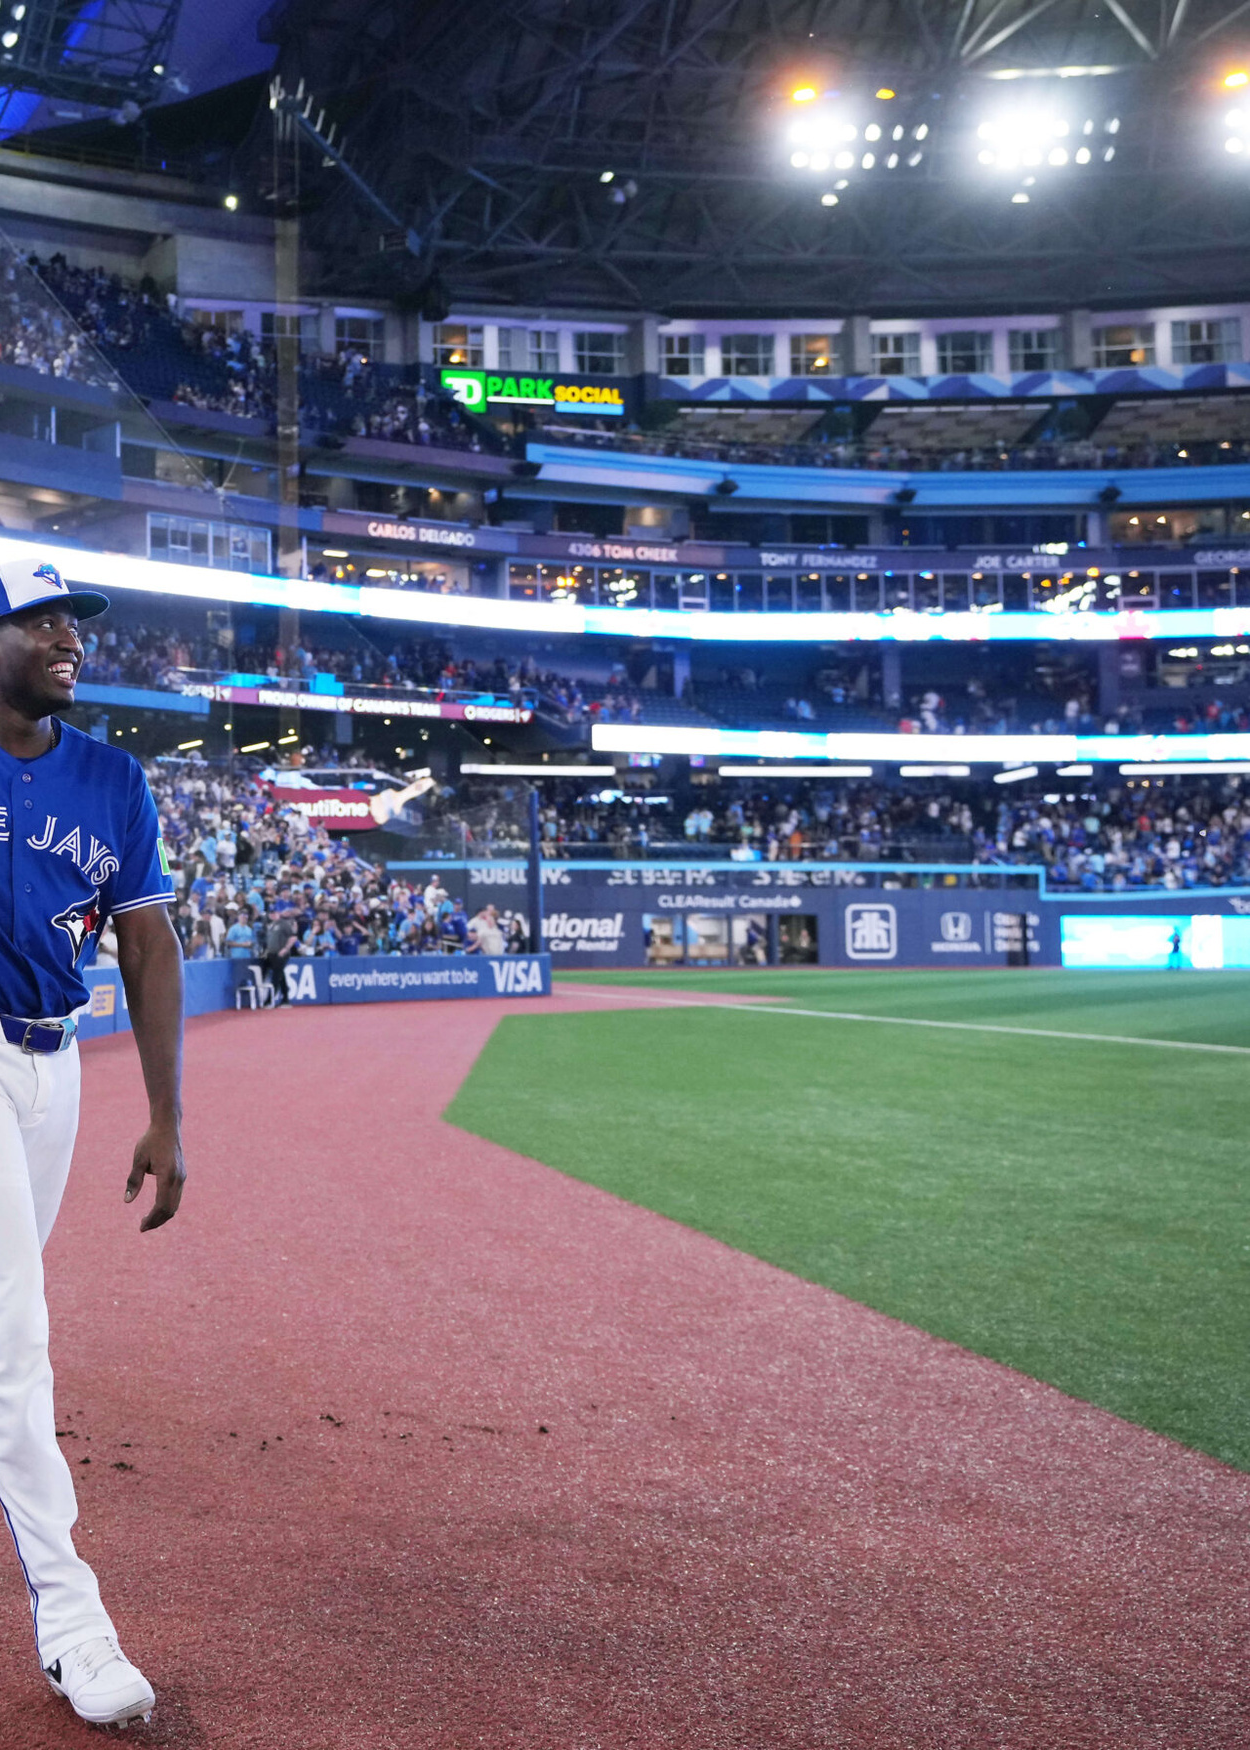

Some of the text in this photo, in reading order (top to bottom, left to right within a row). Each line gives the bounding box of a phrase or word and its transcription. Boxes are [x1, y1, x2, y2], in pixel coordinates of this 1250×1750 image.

[487, 376, 554, 398] PARK
[554, 385, 624, 405] SOCIAL
[367, 522, 475, 547] CARLOS DELGADO
[603, 544, 634, 559] TOM
[635, 546, 678, 562] CHEEK
[760, 552, 878, 569] TONY FERNANDEZ
[972, 555, 1060, 569] JOE CARTER
[258, 689, 297, 706] PROUD
[475, 706, 515, 722] ROGERS
[26, 815, 120, 886] JAYS
[549, 939, 618, 951] Car Rental
[329, 967, 479, 991] everywhere you want to be
[489, 961, 543, 993] VISA
